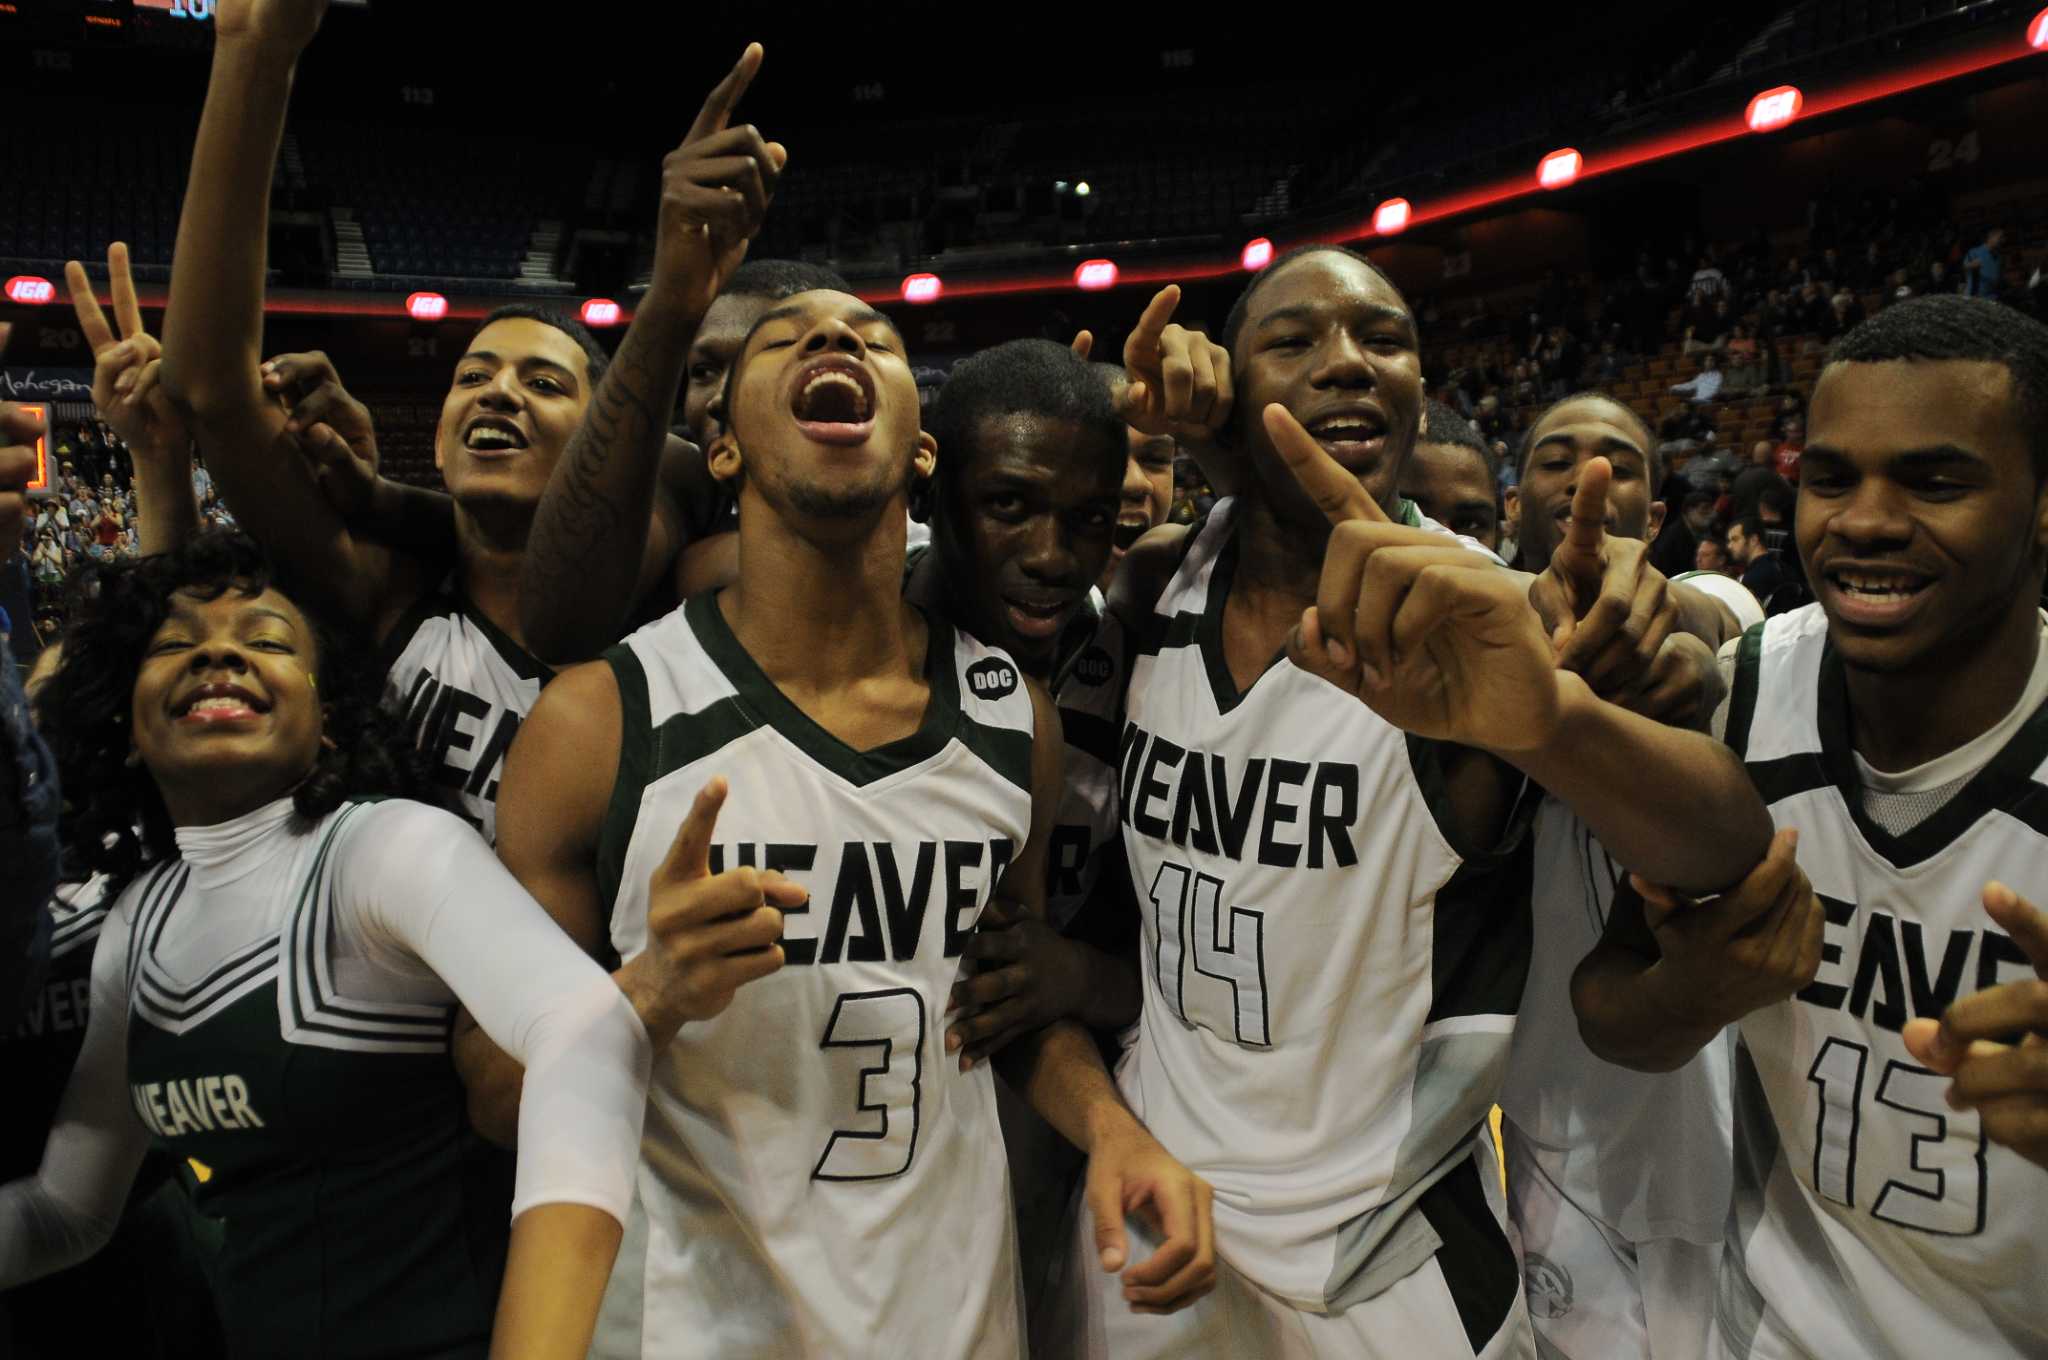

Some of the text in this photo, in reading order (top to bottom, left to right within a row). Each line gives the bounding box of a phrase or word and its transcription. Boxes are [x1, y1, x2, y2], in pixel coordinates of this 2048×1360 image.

[11, 281, 51, 301] IGA
[973, 668, 1013, 690] DOC
[1149, 861, 1272, 1046] 14
[130, 1074, 266, 1137] WEAVER
[810, 987, 926, 1182] 3
[1808, 1036, 1989, 1236] 13
